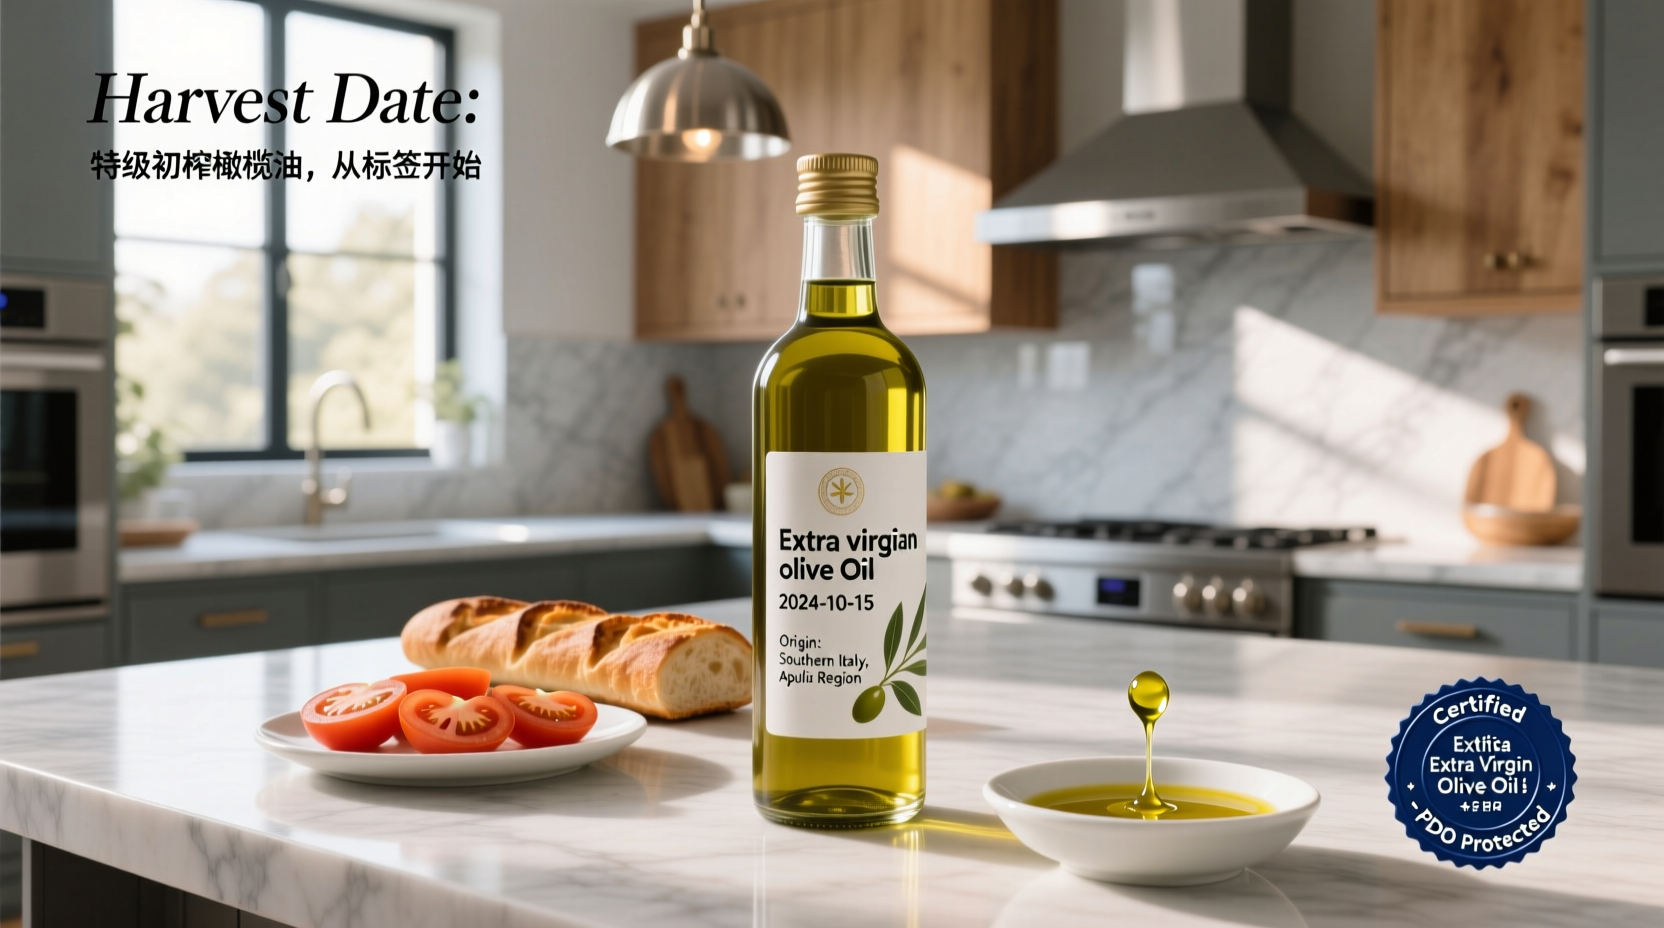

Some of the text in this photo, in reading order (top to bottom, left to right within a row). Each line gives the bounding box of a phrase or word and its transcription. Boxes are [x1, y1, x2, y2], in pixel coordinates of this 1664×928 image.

[779, 527, 918, 558] Extra virgian
[779, 556, 874, 580] olive Oil
[779, 594, 874, 611] 2024-10-15
[779, 634, 822, 652] Origin:
[779, 652, 869, 672] Southern Italy,
[817, 670, 862, 688] Region
